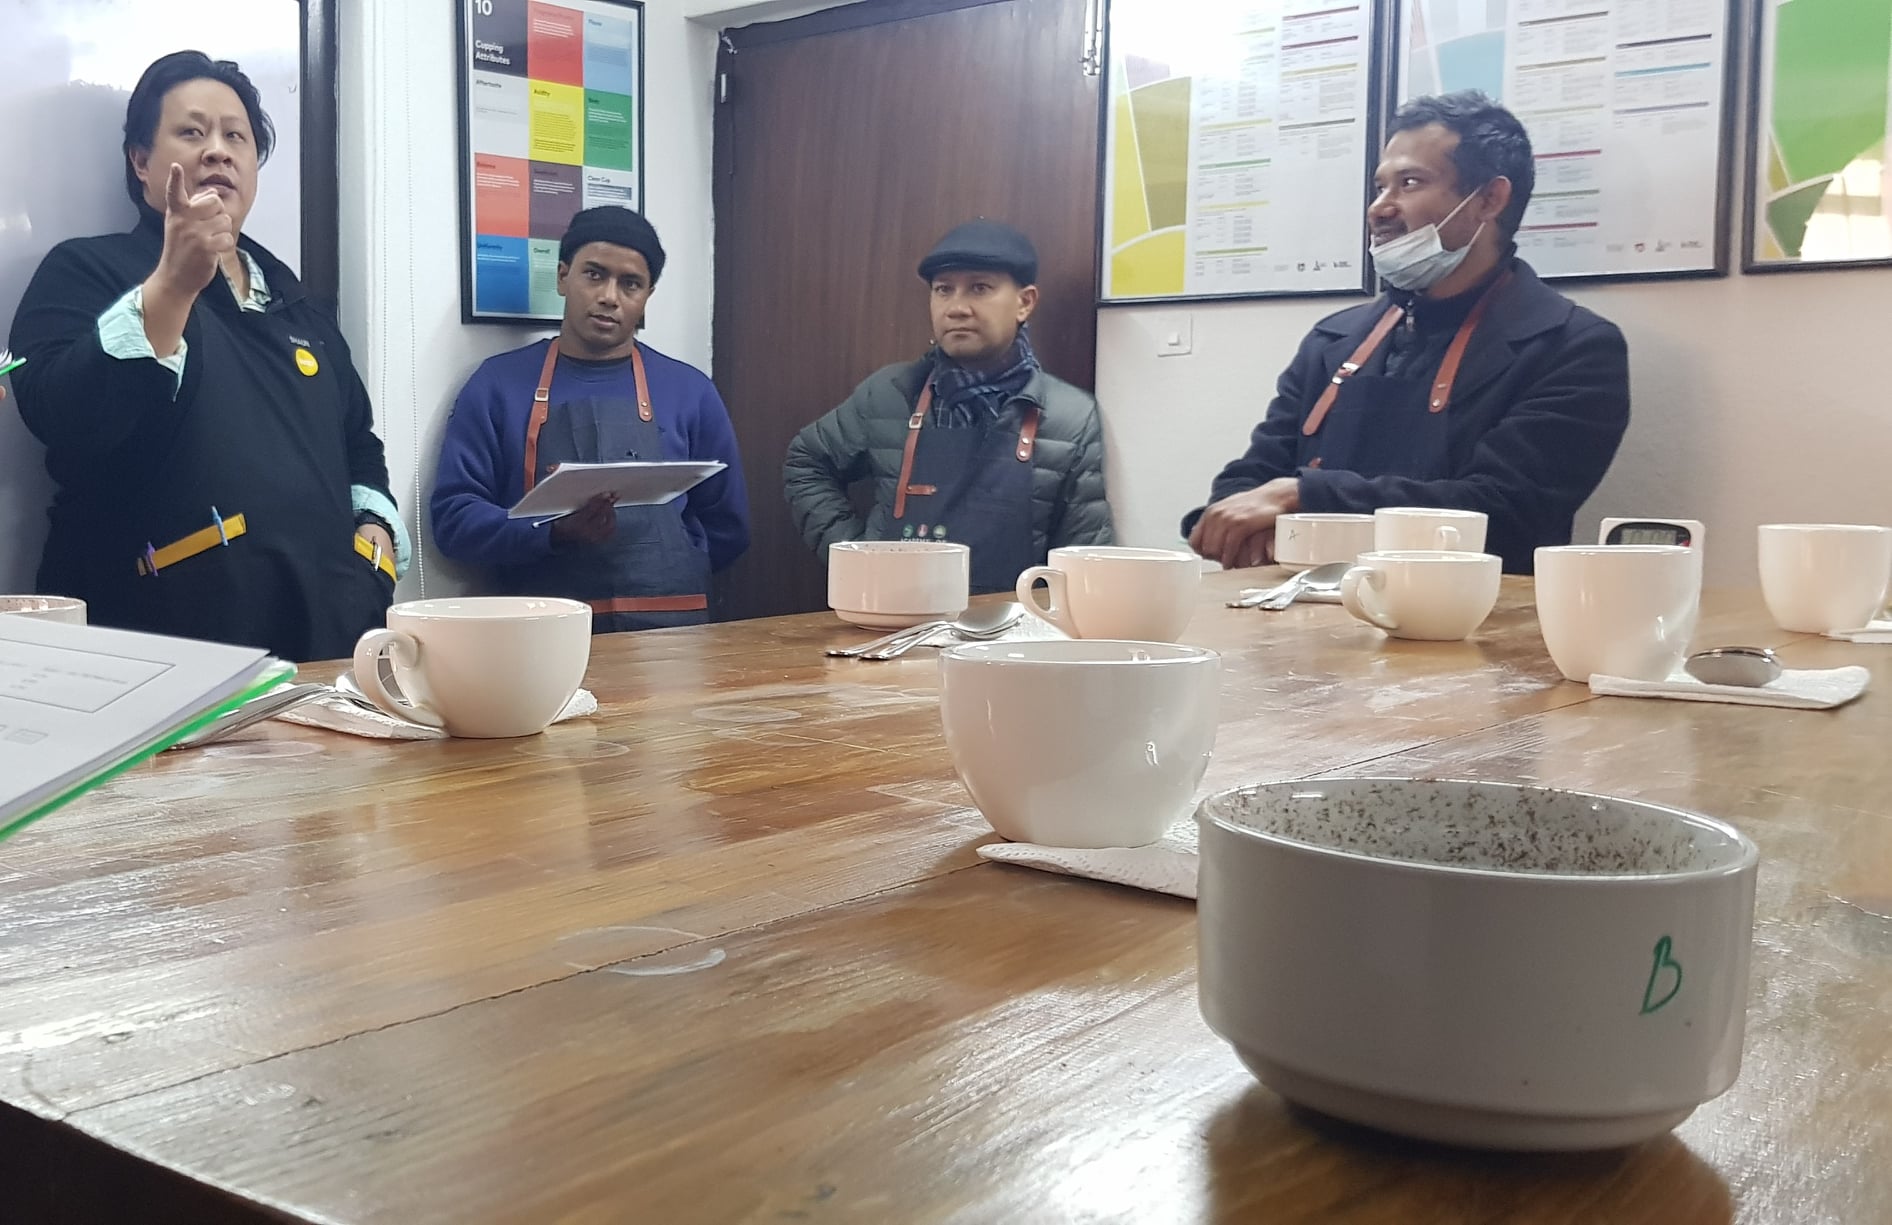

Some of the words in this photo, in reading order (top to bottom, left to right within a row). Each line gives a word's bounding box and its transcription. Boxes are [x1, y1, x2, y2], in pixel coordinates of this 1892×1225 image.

[475, 0, 493, 16] 10
[475, 40, 504, 54] Cupping
[475, 51, 511, 65] Attributes
[1638, 935, 1682, 1016] B
